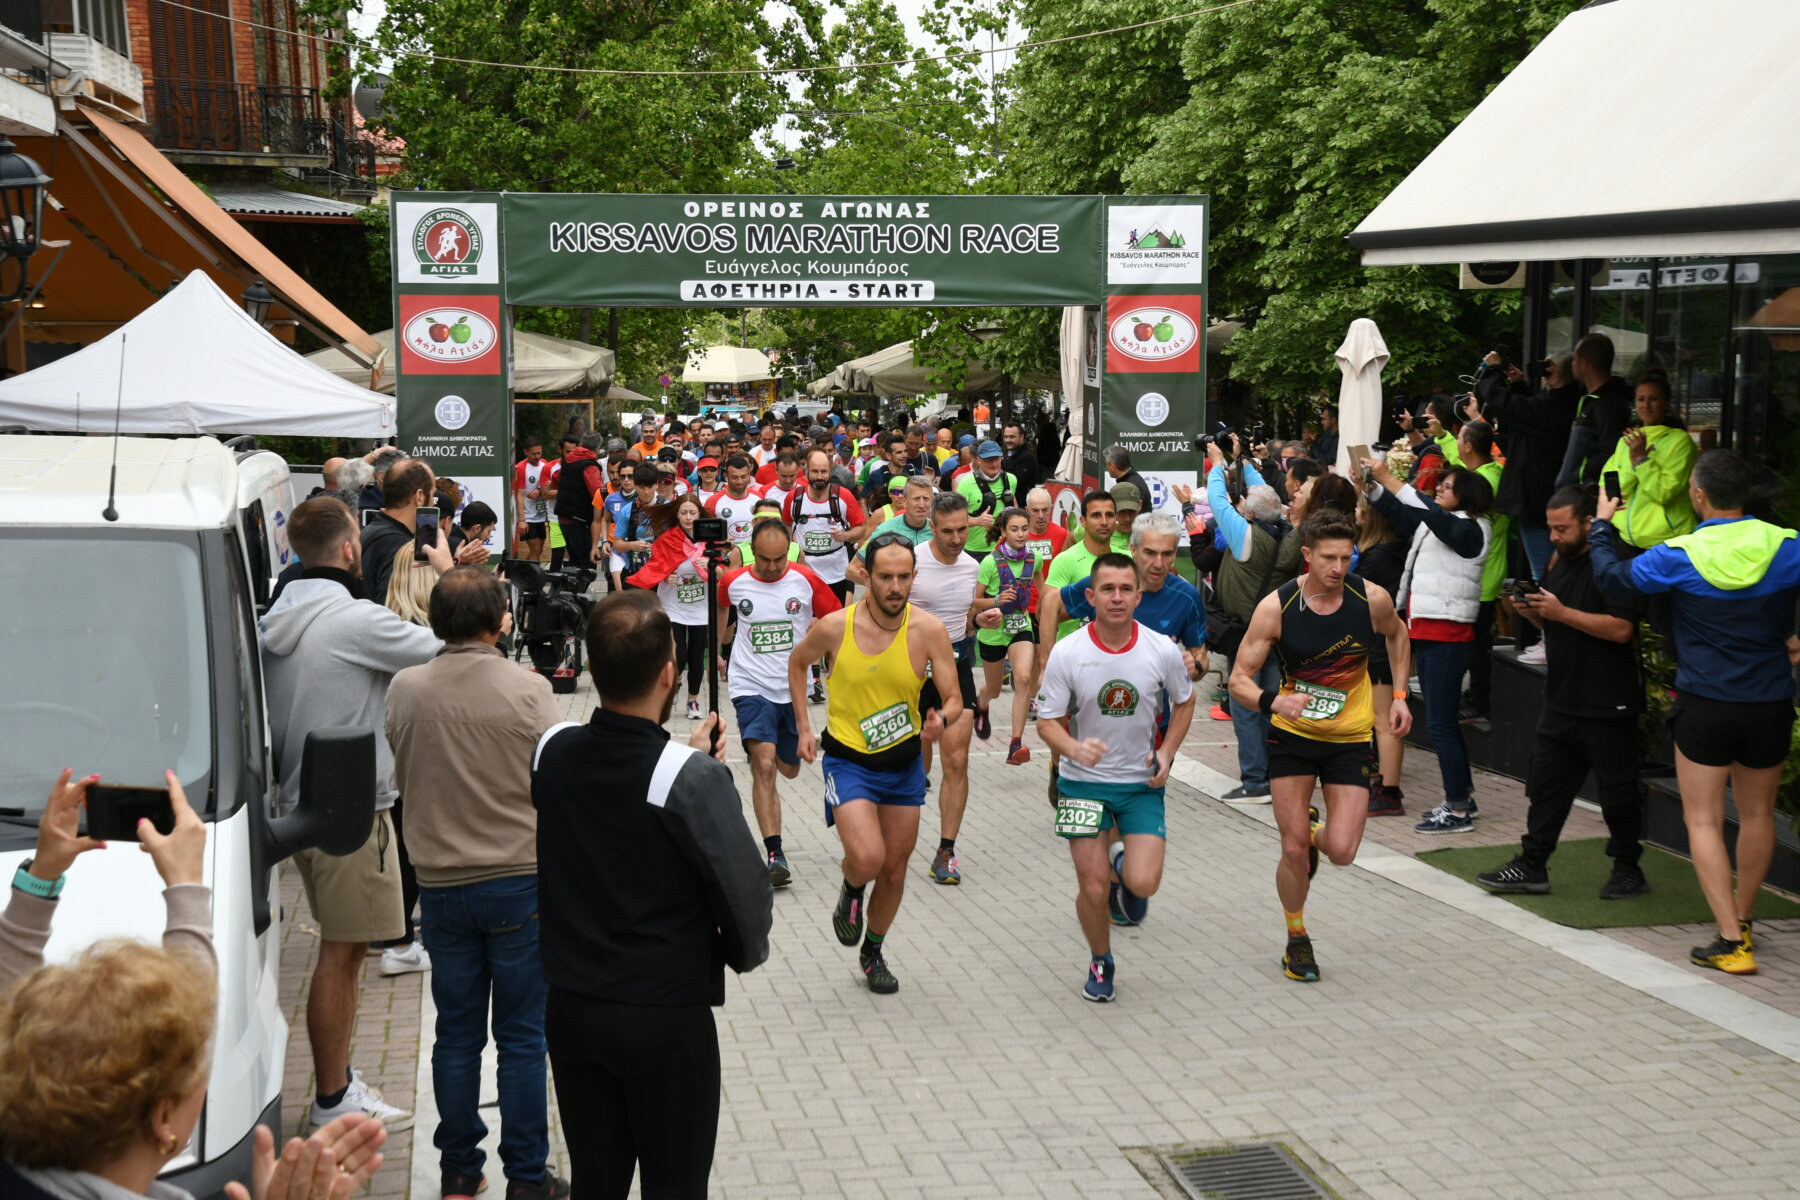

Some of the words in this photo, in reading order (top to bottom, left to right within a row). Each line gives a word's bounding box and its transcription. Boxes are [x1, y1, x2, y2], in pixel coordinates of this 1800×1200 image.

[684, 201, 803, 217] ΟΡΕΙΝΟΣ
[820, 202, 930, 218] ΑΓΩΝΑΣ
[436, 212, 470, 226] ΔΡΟΜΕΩΝ
[550, 222, 737, 252] KISSAVOS
[745, 223, 951, 253] MARATHON
[960, 223, 1060, 253] RACE
[705, 259, 801, 277] Ευάγγελος
[807, 260, 909, 277] Κουμπάρος
[692, 283, 820, 298] ΑΦΕΤΗΡΙΑ
[848, 283, 923, 298] START
[415, 337, 444, 355] Μήλα
[450, 338, 485, 356] Αγιάς
[1120, 337, 1147, 353] Μήλα
[1153, 337, 1186, 354] Αγιάς
[411, 446, 457, 457] ΔΗΜΟΣ
[460, 445, 495, 457] ΑΓΙΑΣ
[1158, 441, 1190, 452] ΑΓΙΑΣ
[807, 538, 830, 546] 2402
[680, 588, 703, 598] 2393
[754, 631, 790, 645] 2384
[1307, 695, 1339, 714] 389
[868, 713, 907, 744] 2360
[1058, 809, 1098, 826] 2302
